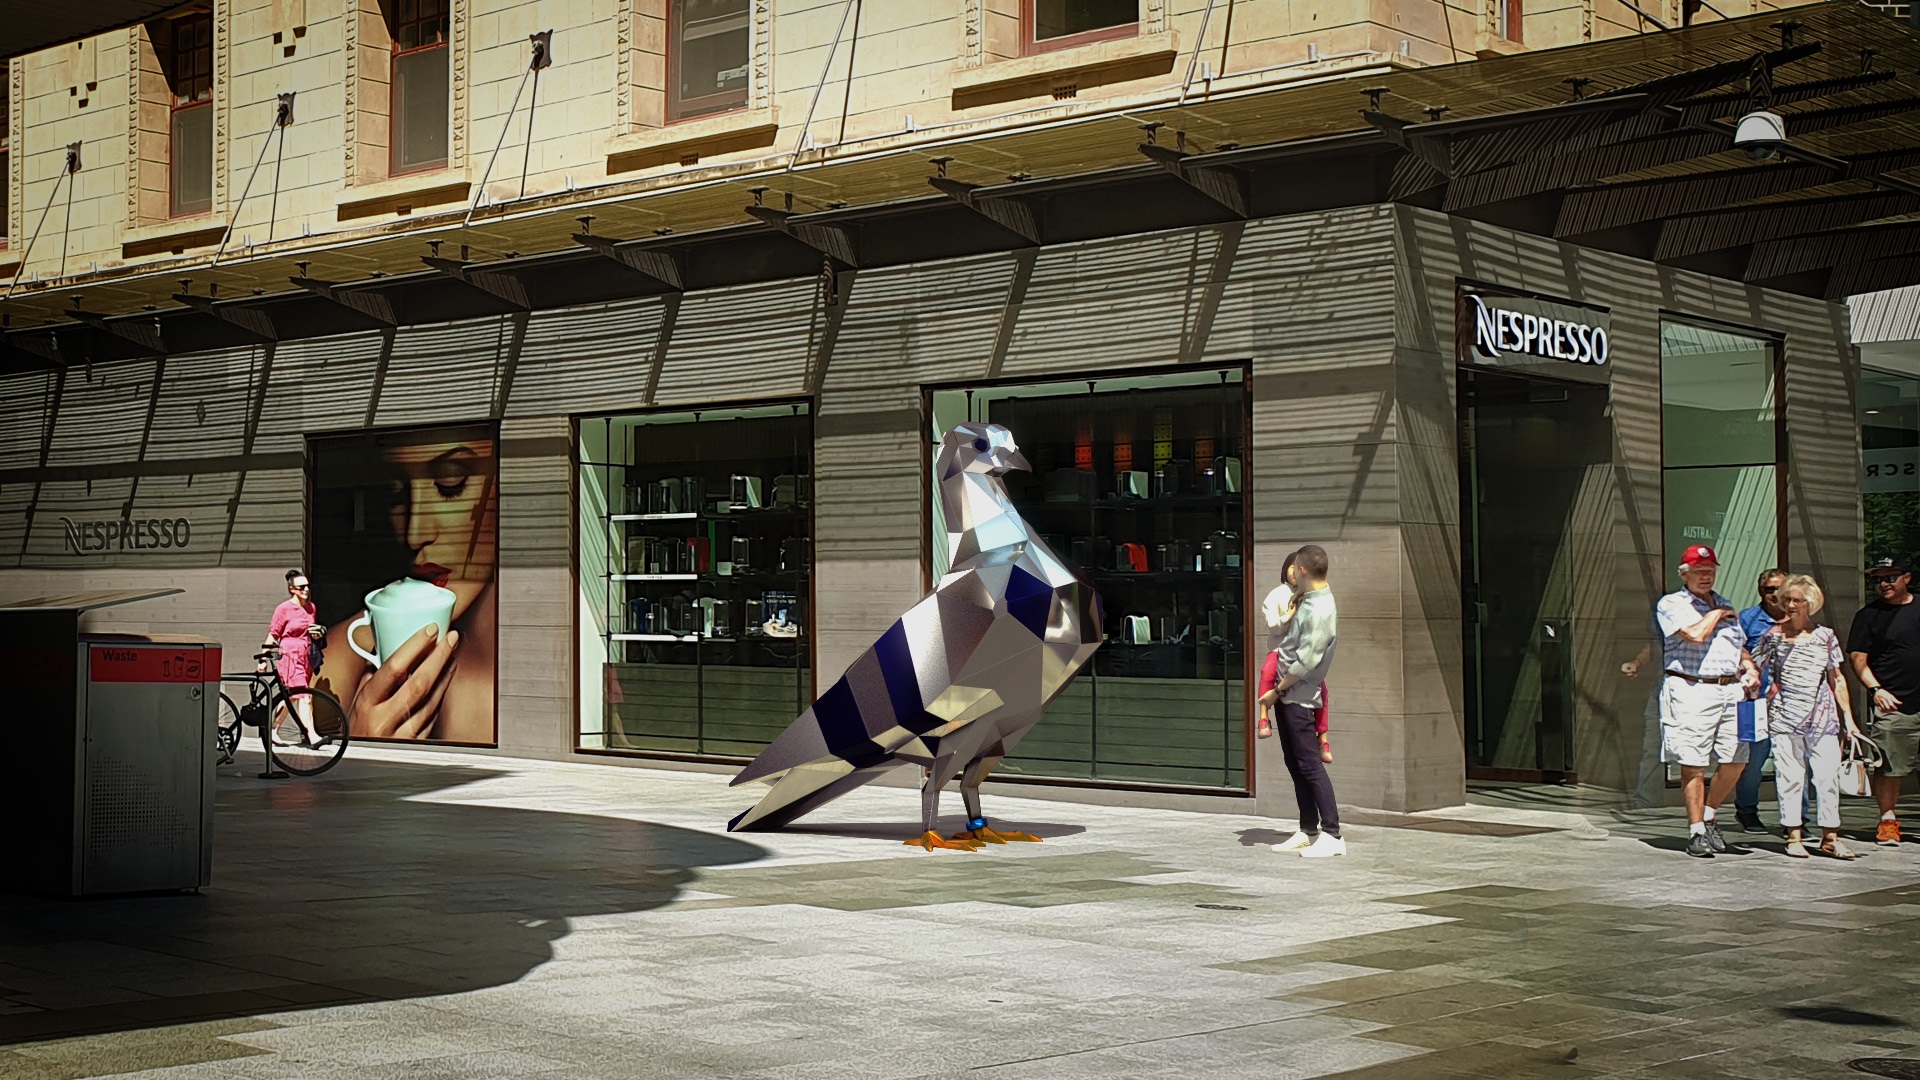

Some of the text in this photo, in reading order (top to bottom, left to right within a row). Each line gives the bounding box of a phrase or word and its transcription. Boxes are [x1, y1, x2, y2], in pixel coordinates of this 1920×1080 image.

[1464, 294, 1608, 366] NESPRESSO
[59, 516, 191, 556] NESPRESSO
[102, 650, 138, 662] Waste
